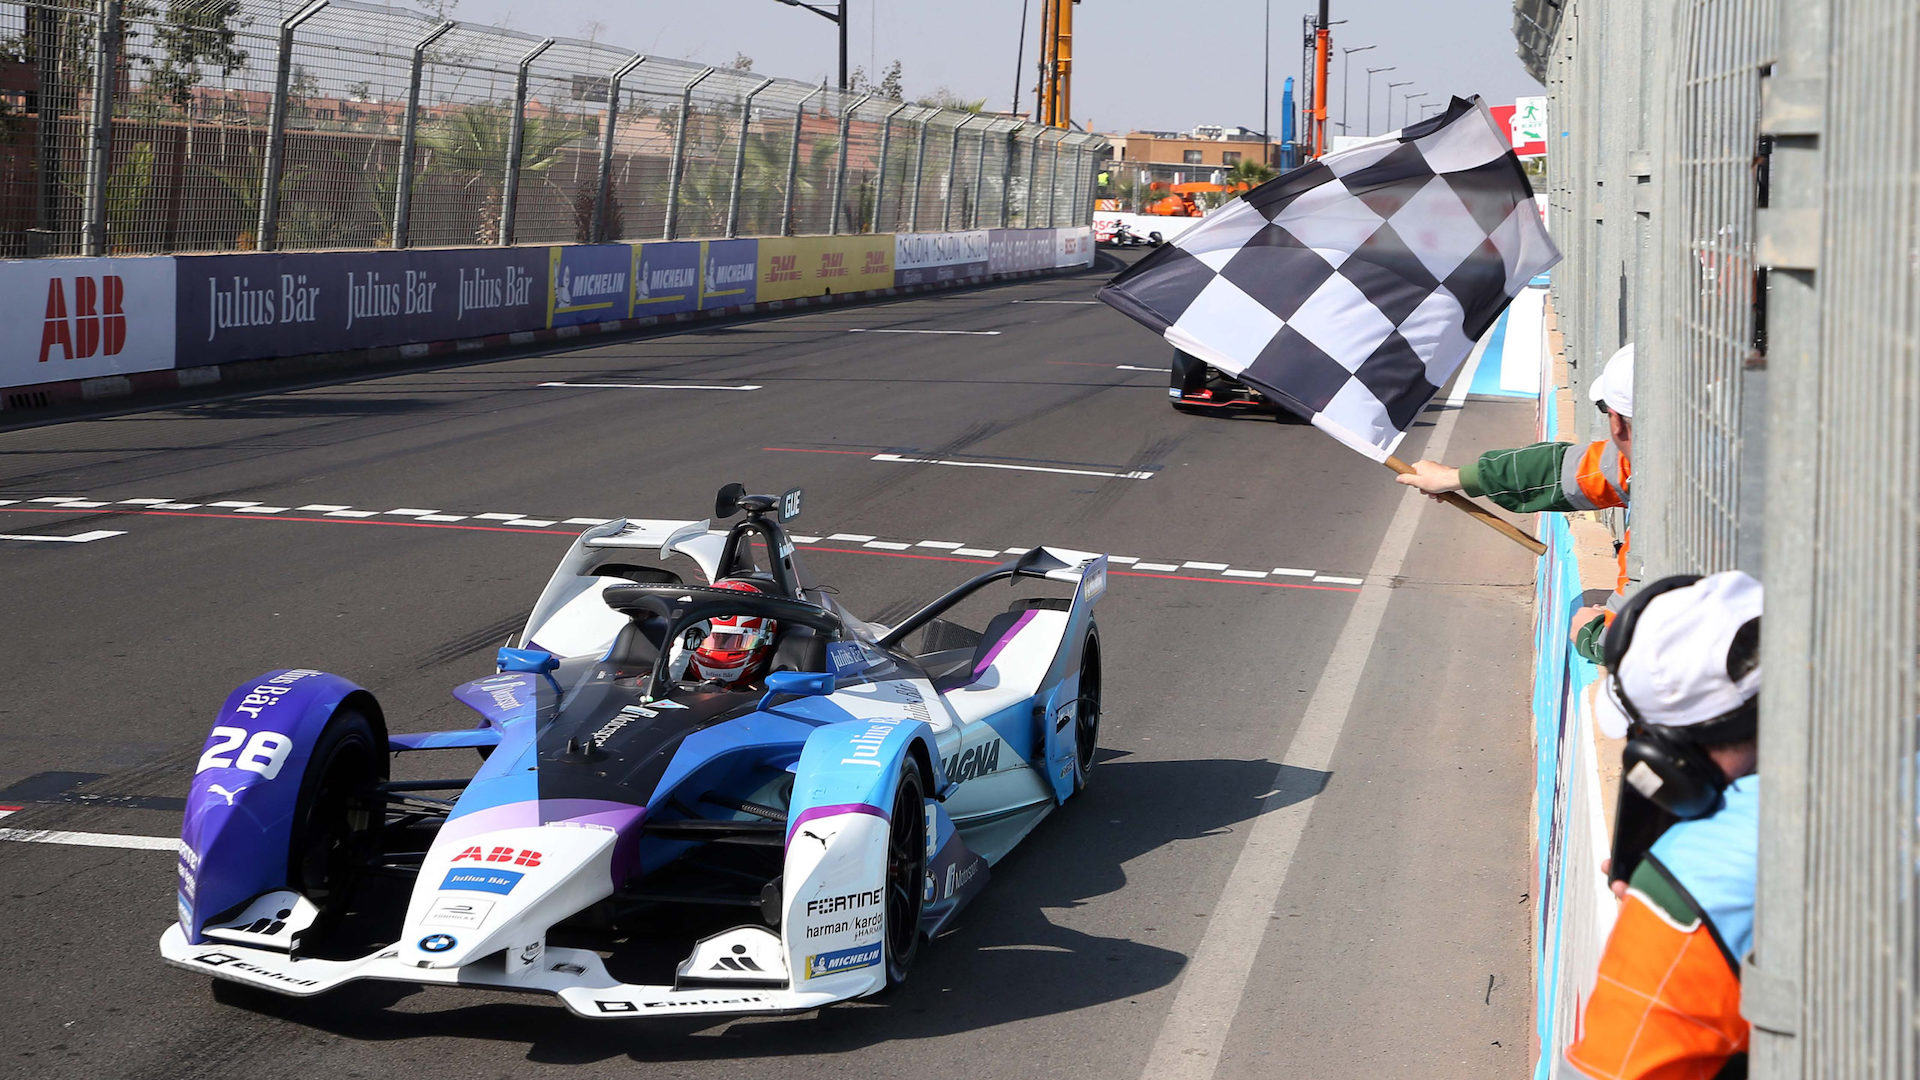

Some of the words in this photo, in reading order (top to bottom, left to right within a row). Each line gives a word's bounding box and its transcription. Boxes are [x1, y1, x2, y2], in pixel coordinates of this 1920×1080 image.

[572, 273, 625, 297] MICHELIN
[650, 268, 695, 290] MICHELIN
[715, 263, 755, 284] MICHELIN
[208, 277, 274, 341] Julius
[280, 274, 320, 323] Bär
[346, 272, 400, 330] Julius
[405, 270, 437, 314] Bär
[457, 268, 501, 320] Julius
[505, 266, 533, 306] Bär
[38, 275, 127, 363] ABB
[784, 490, 801, 519] GUE
[235, 685, 293, 719] Bär
[195, 725, 293, 780] 28
[841, 725, 894, 768] Julius
[941, 737, 1000, 785] AGNA
[451, 846, 543, 867] ABB
[807, 886, 884, 917] FORTINET
[828, 949, 880, 969] MICHELIN
[231, 963, 320, 987] Einhell
[643, 997, 762, 1008] Einhell
